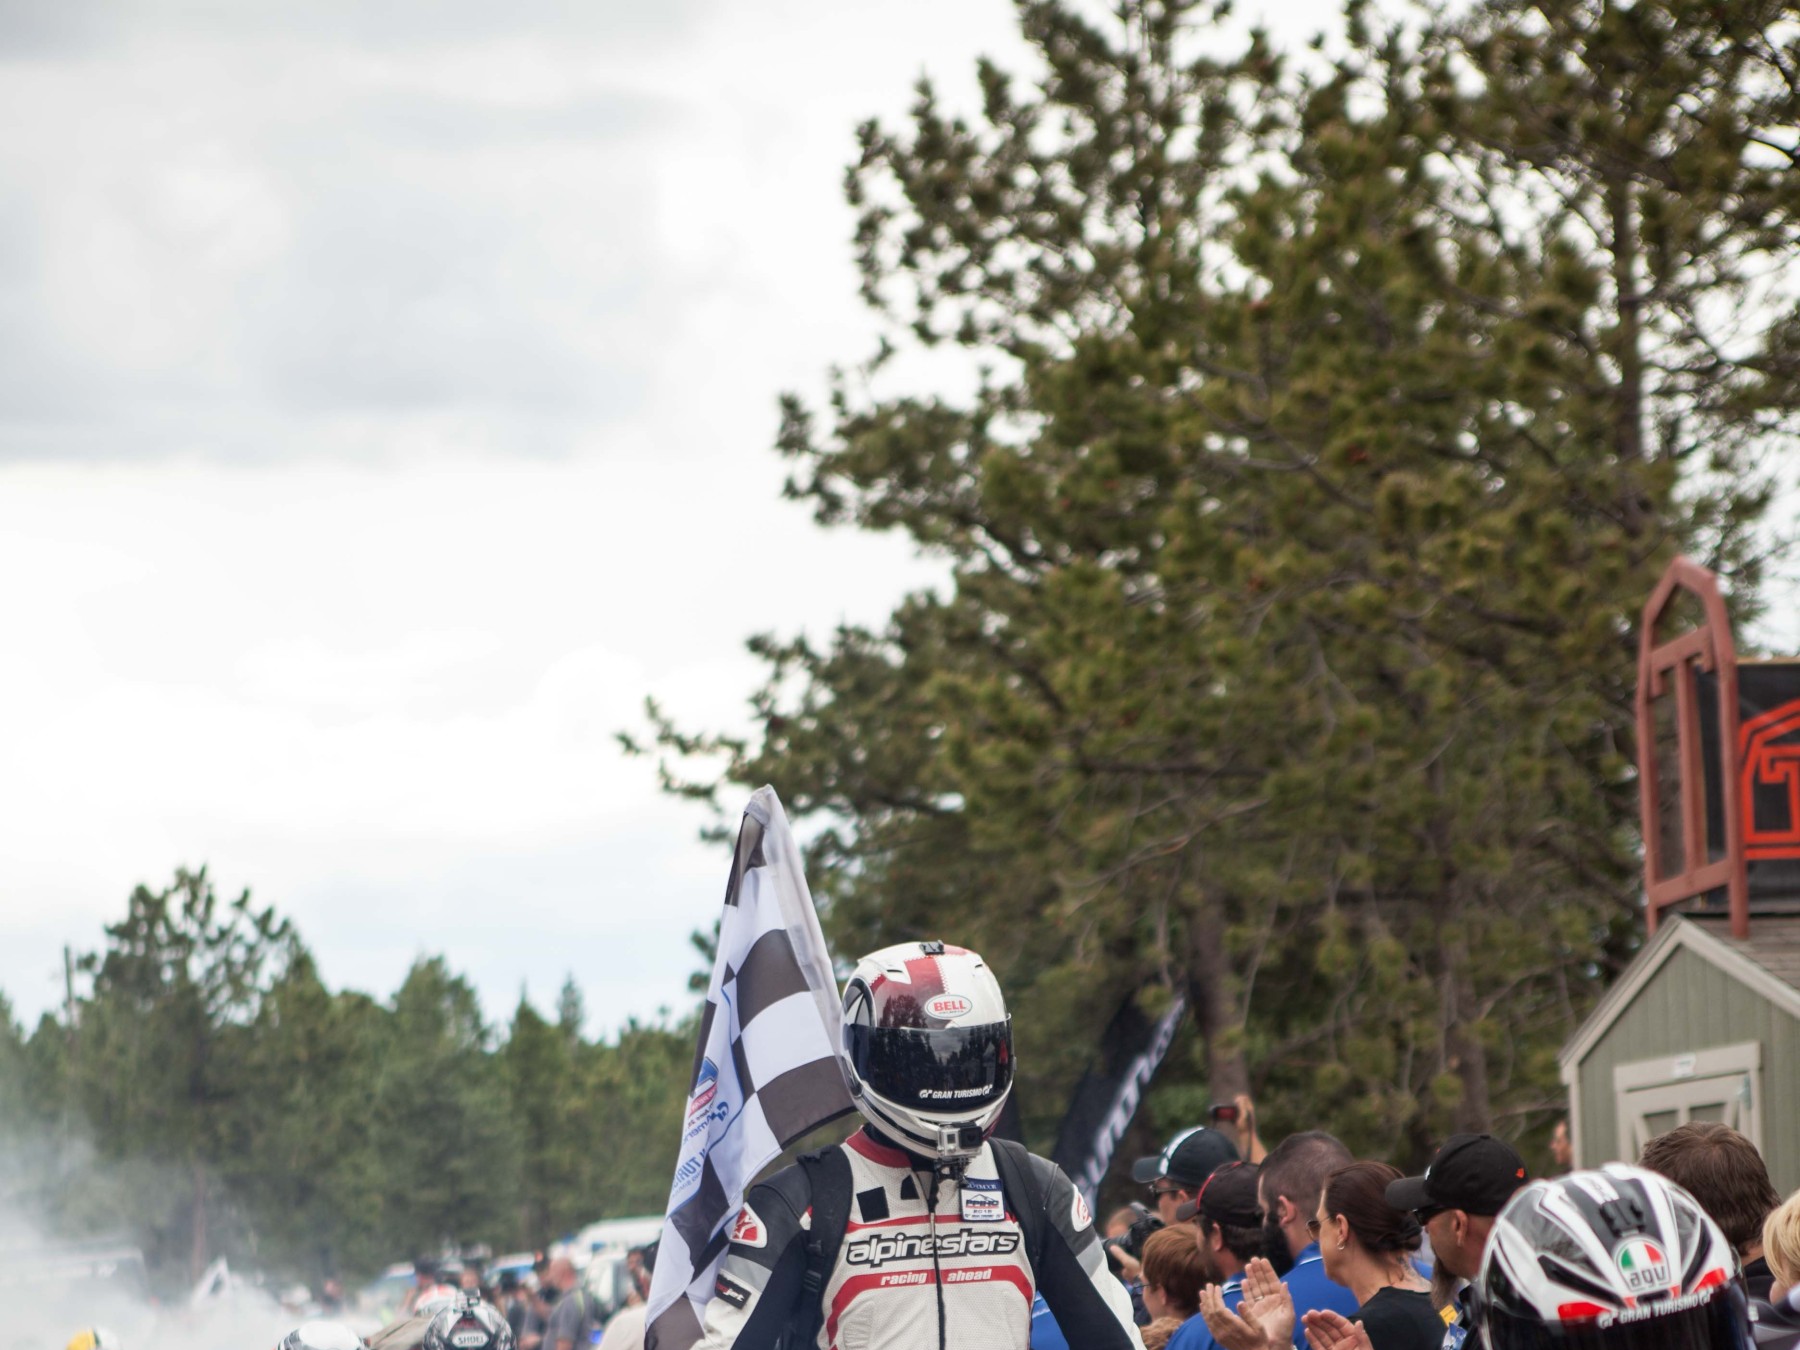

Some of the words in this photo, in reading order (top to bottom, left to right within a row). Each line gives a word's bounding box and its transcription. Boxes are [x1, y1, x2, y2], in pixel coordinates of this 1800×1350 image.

[934, 1000, 966, 1012] BELL
[933, 1090, 951, 1099] GRAN
[954, 1088, 982, 1098] TURISMO
[847, 1229, 1019, 1266] alpinestars
[881, 1272, 927, 1286] racing
[947, 1269, 992, 1282] ahead
[1629, 1266, 1667, 1289] agv
[1618, 1304, 1651, 1324] GRAN
[1653, 1294, 1699, 1317] TURISMO
